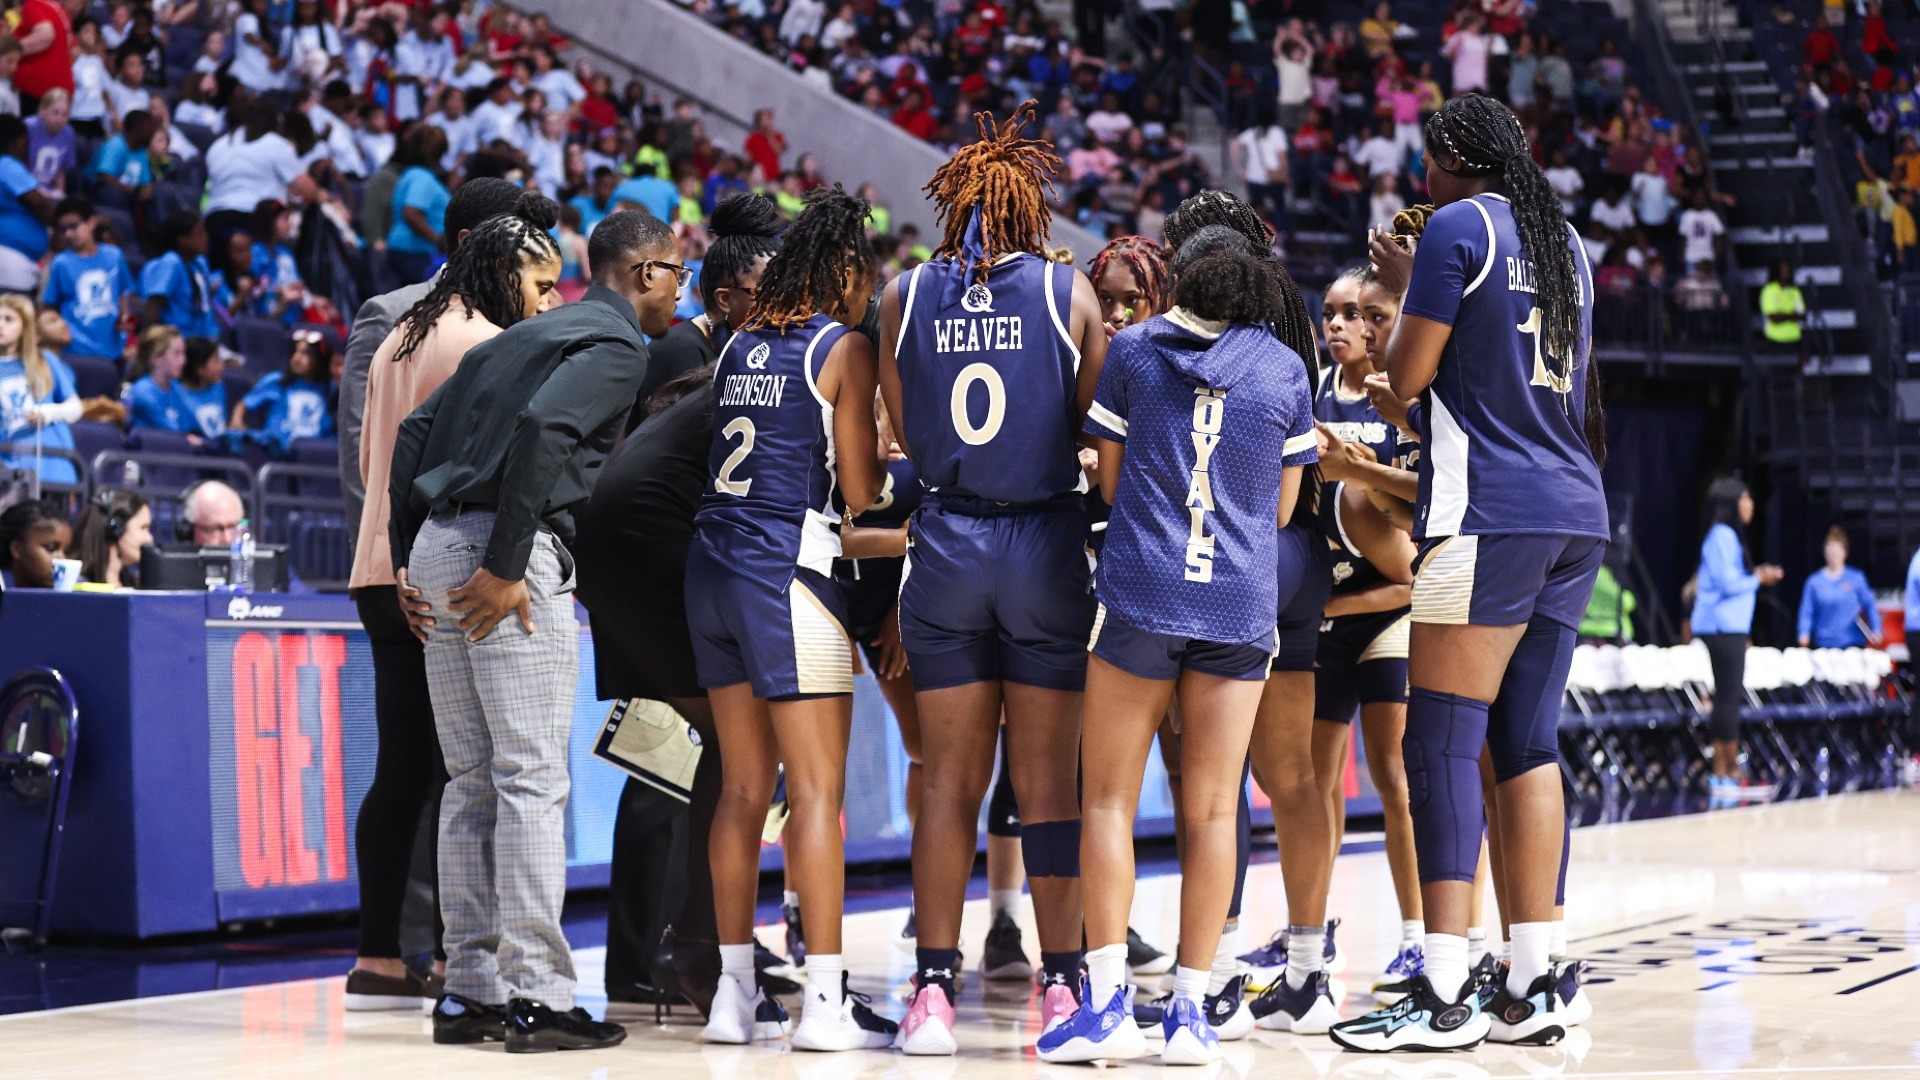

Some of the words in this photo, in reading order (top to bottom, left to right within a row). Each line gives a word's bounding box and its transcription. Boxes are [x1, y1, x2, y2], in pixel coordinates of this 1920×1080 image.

[934, 316, 1022, 353] WEAVER
[719, 375, 787, 407] JOHNSON
[951, 362, 1006, 445] 0
[714, 416, 756, 497] 2
[1185, 387, 1227, 583] OYALS
[231, 631, 347, 889] GET
